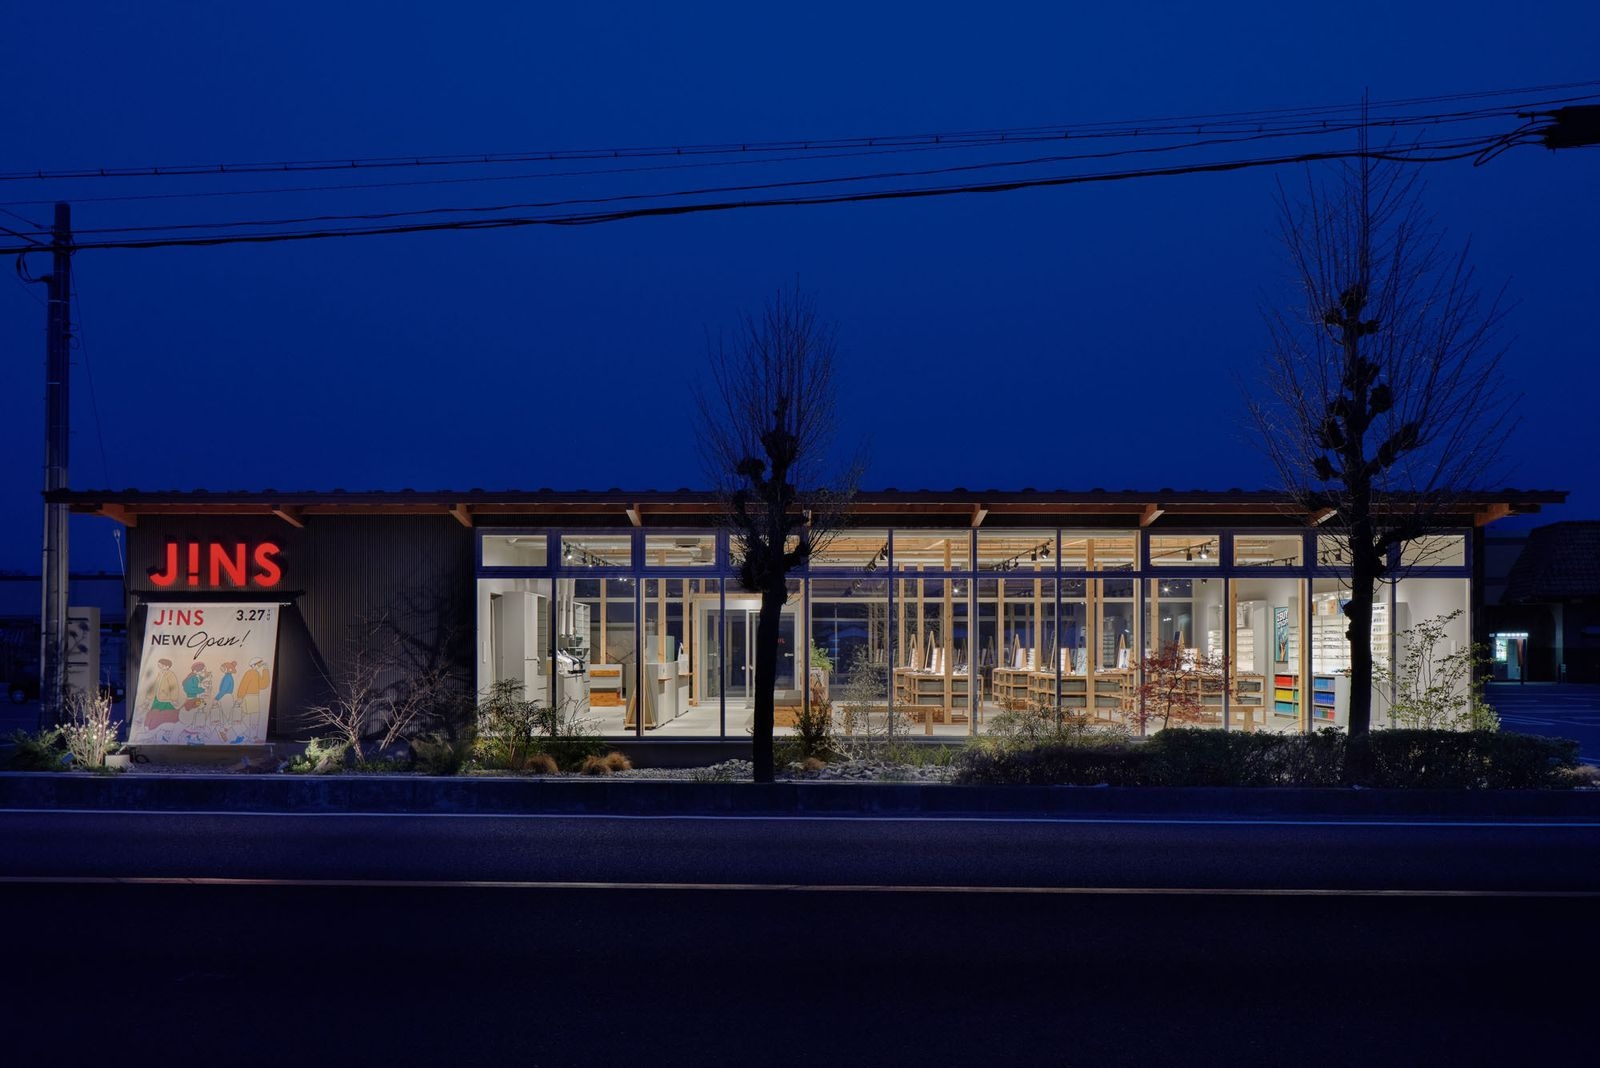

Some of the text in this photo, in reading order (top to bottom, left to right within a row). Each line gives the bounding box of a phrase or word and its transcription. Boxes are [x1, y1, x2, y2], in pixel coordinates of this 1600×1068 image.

[149, 542, 281, 587] J!NS
[153, 609, 204, 625] J!NS
[236, 609, 266, 621] 3.27
[151, 629, 251, 660] NEW Open!
